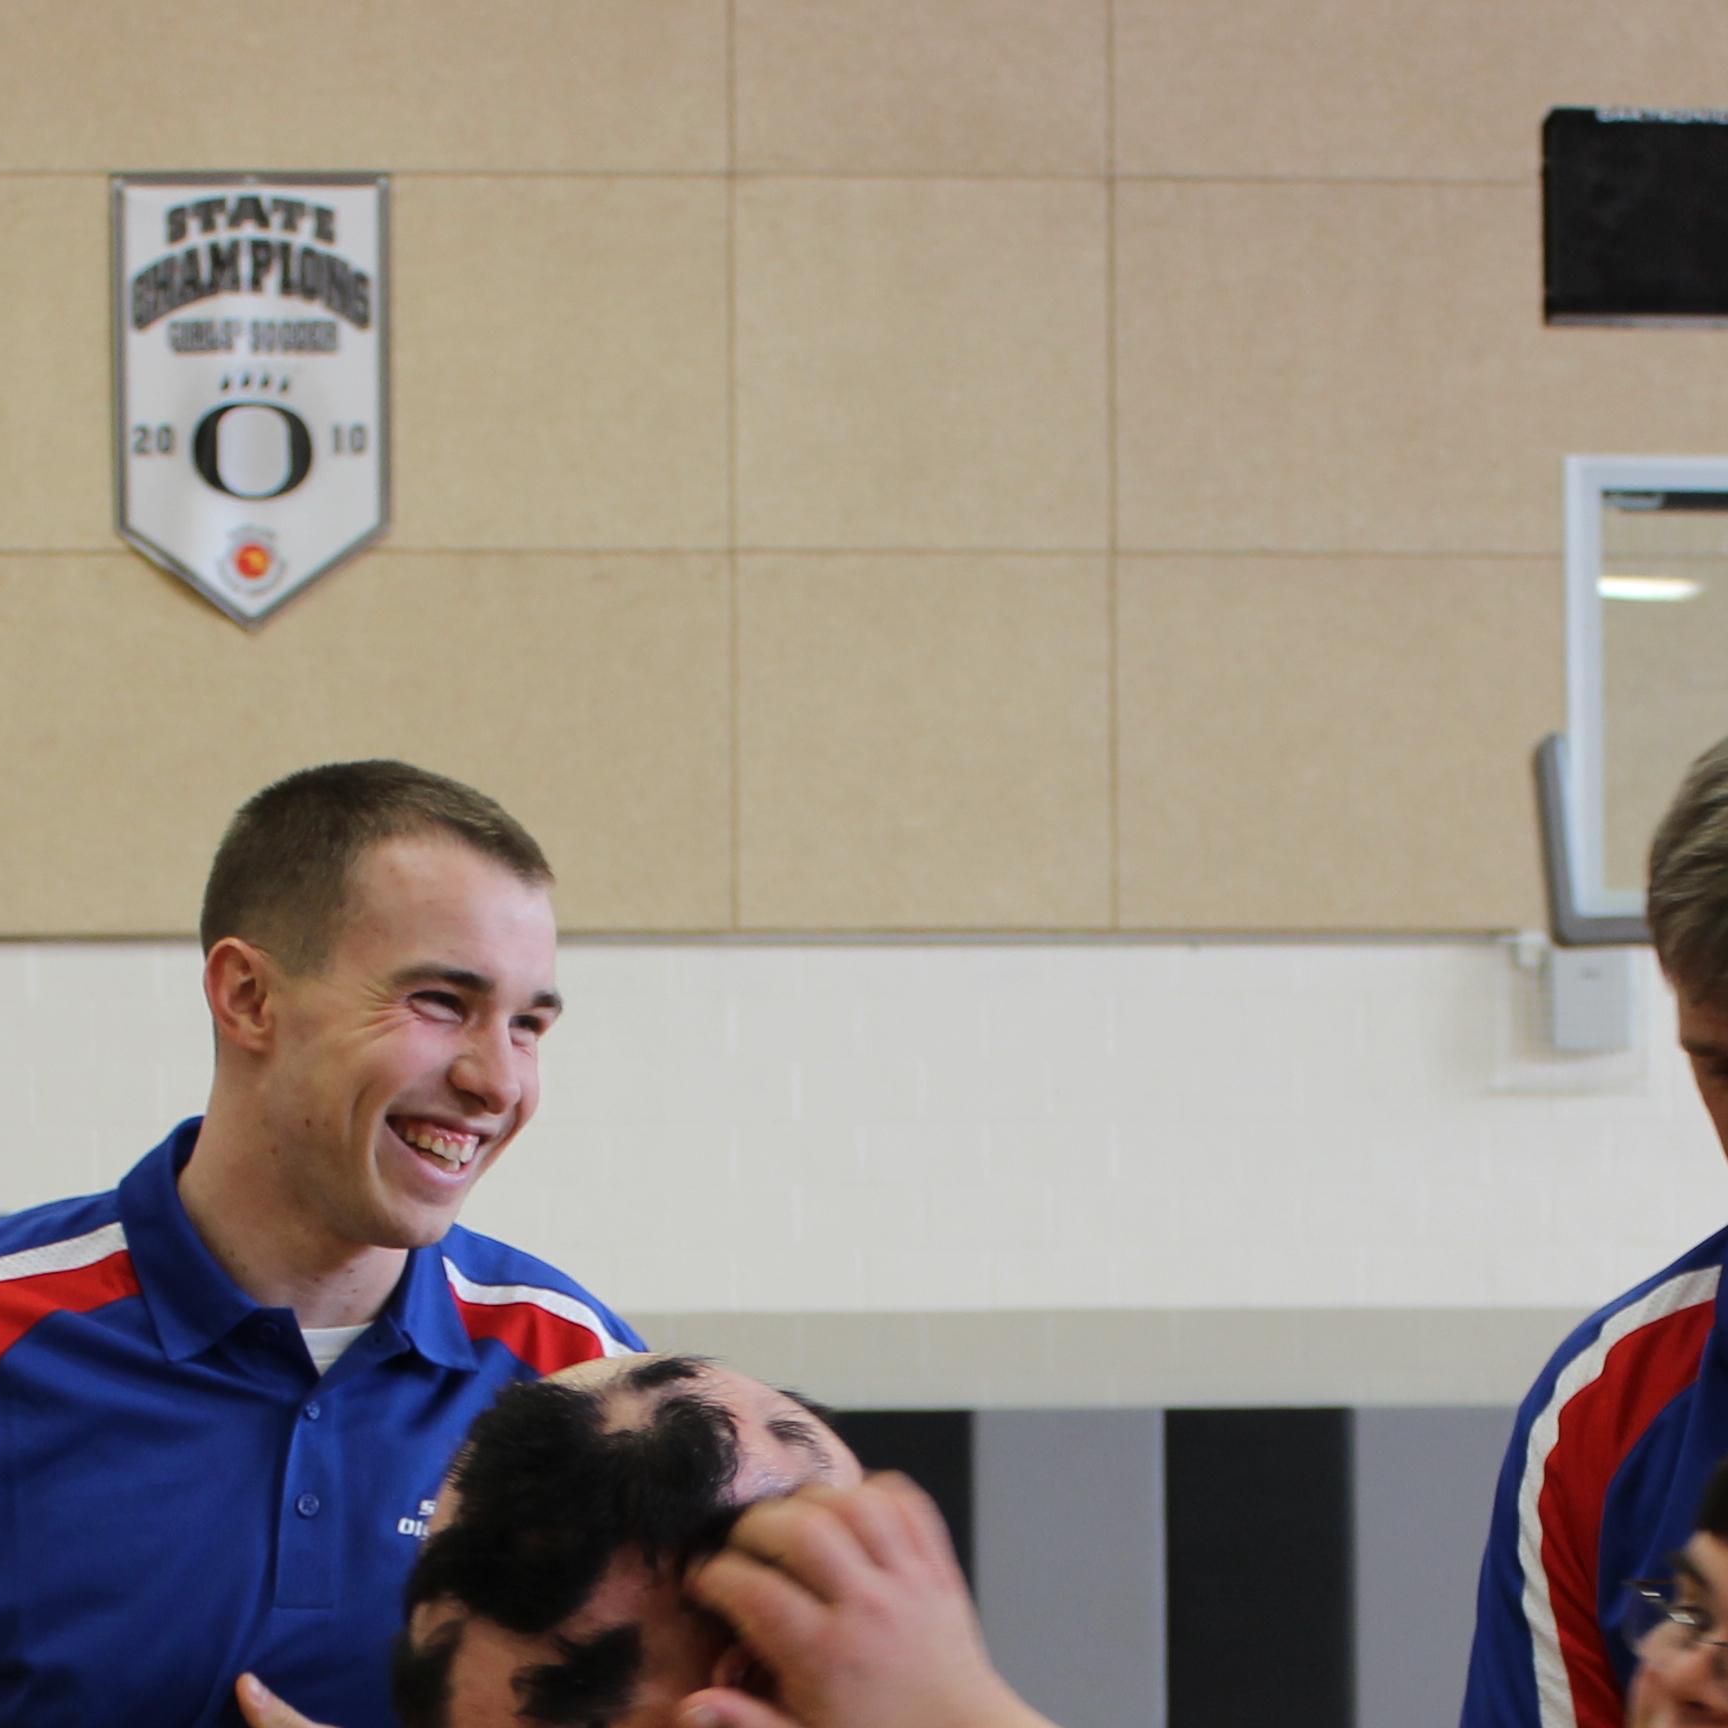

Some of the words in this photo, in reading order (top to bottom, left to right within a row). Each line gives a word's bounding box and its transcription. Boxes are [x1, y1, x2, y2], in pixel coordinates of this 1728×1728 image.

[167, 195, 336, 246] STATE
[131, 238, 372, 333] CHAMPIONS
[133, 424, 176, 455] 20
[332, 424, 367, 455] 10
